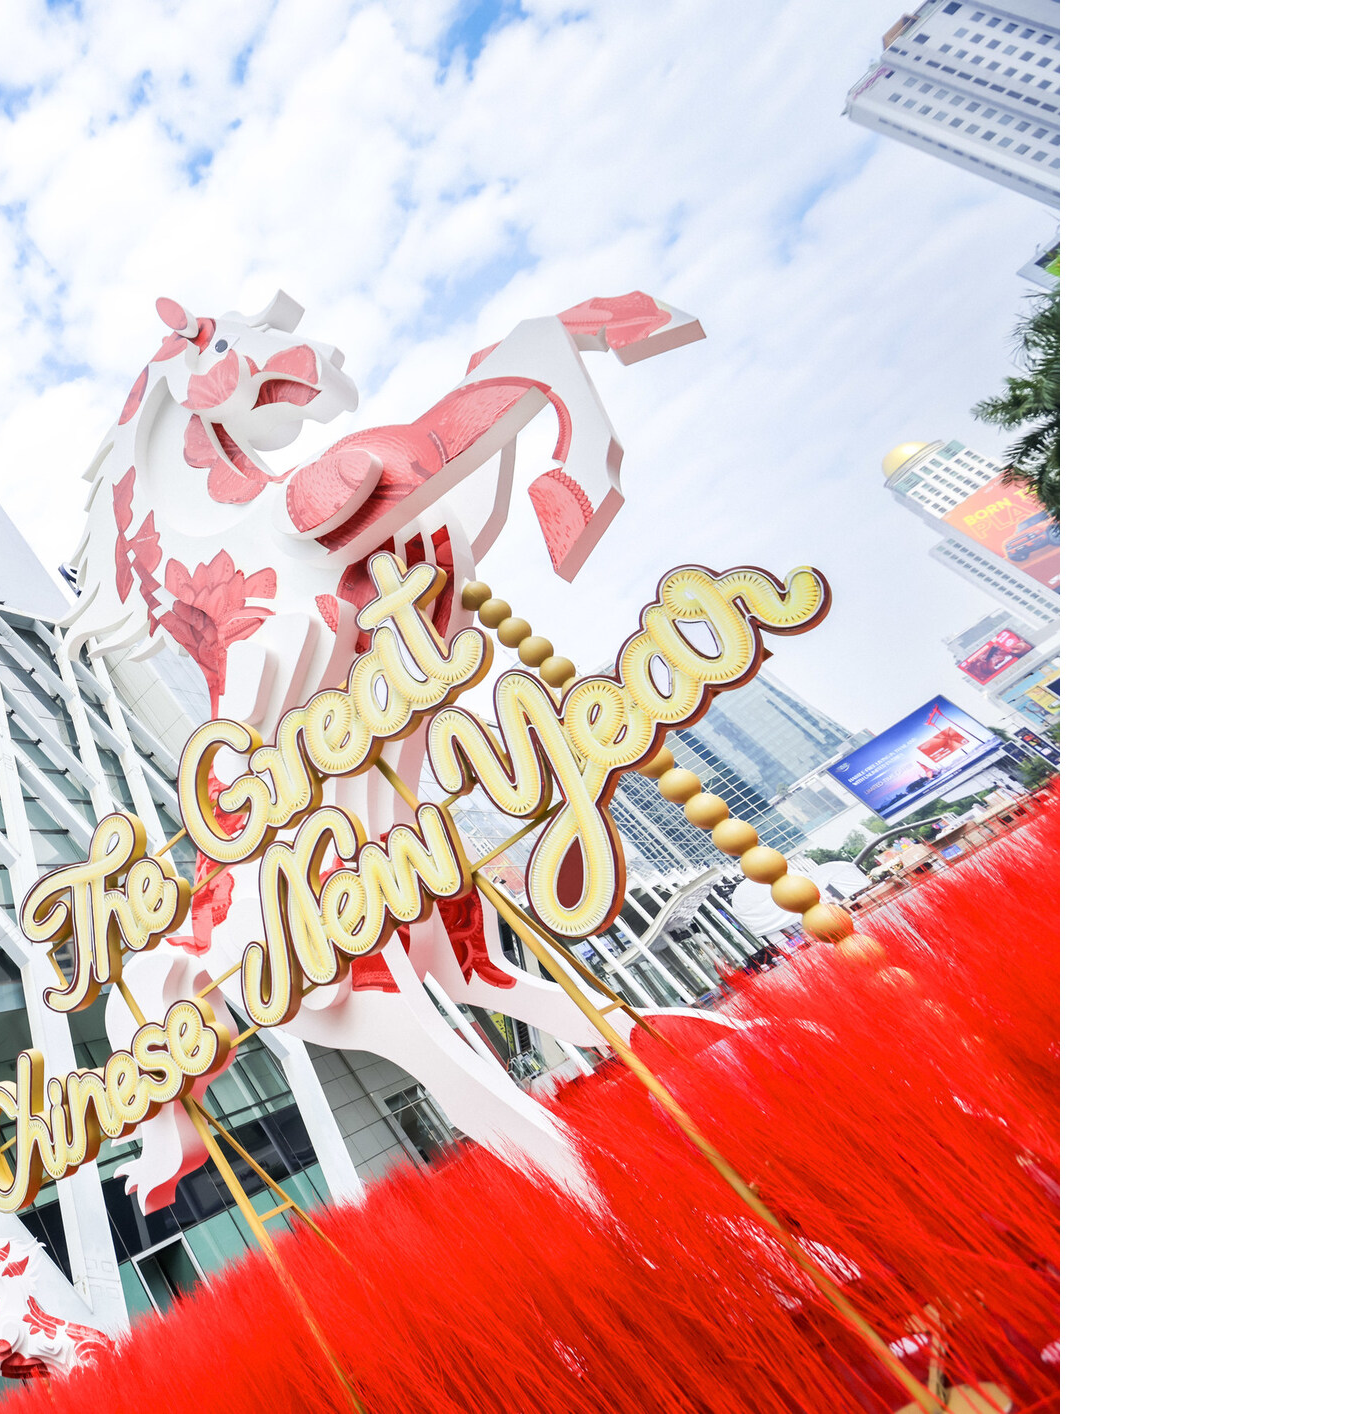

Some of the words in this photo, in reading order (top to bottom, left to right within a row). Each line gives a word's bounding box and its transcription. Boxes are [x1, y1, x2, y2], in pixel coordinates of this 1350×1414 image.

[963, 497, 1012, 526] BORN
[19, 812, 190, 1012] The
[177, 552, 494, 863] Great
[241, 803, 472, 1028] New
[426, 564, 833, 939] Year
